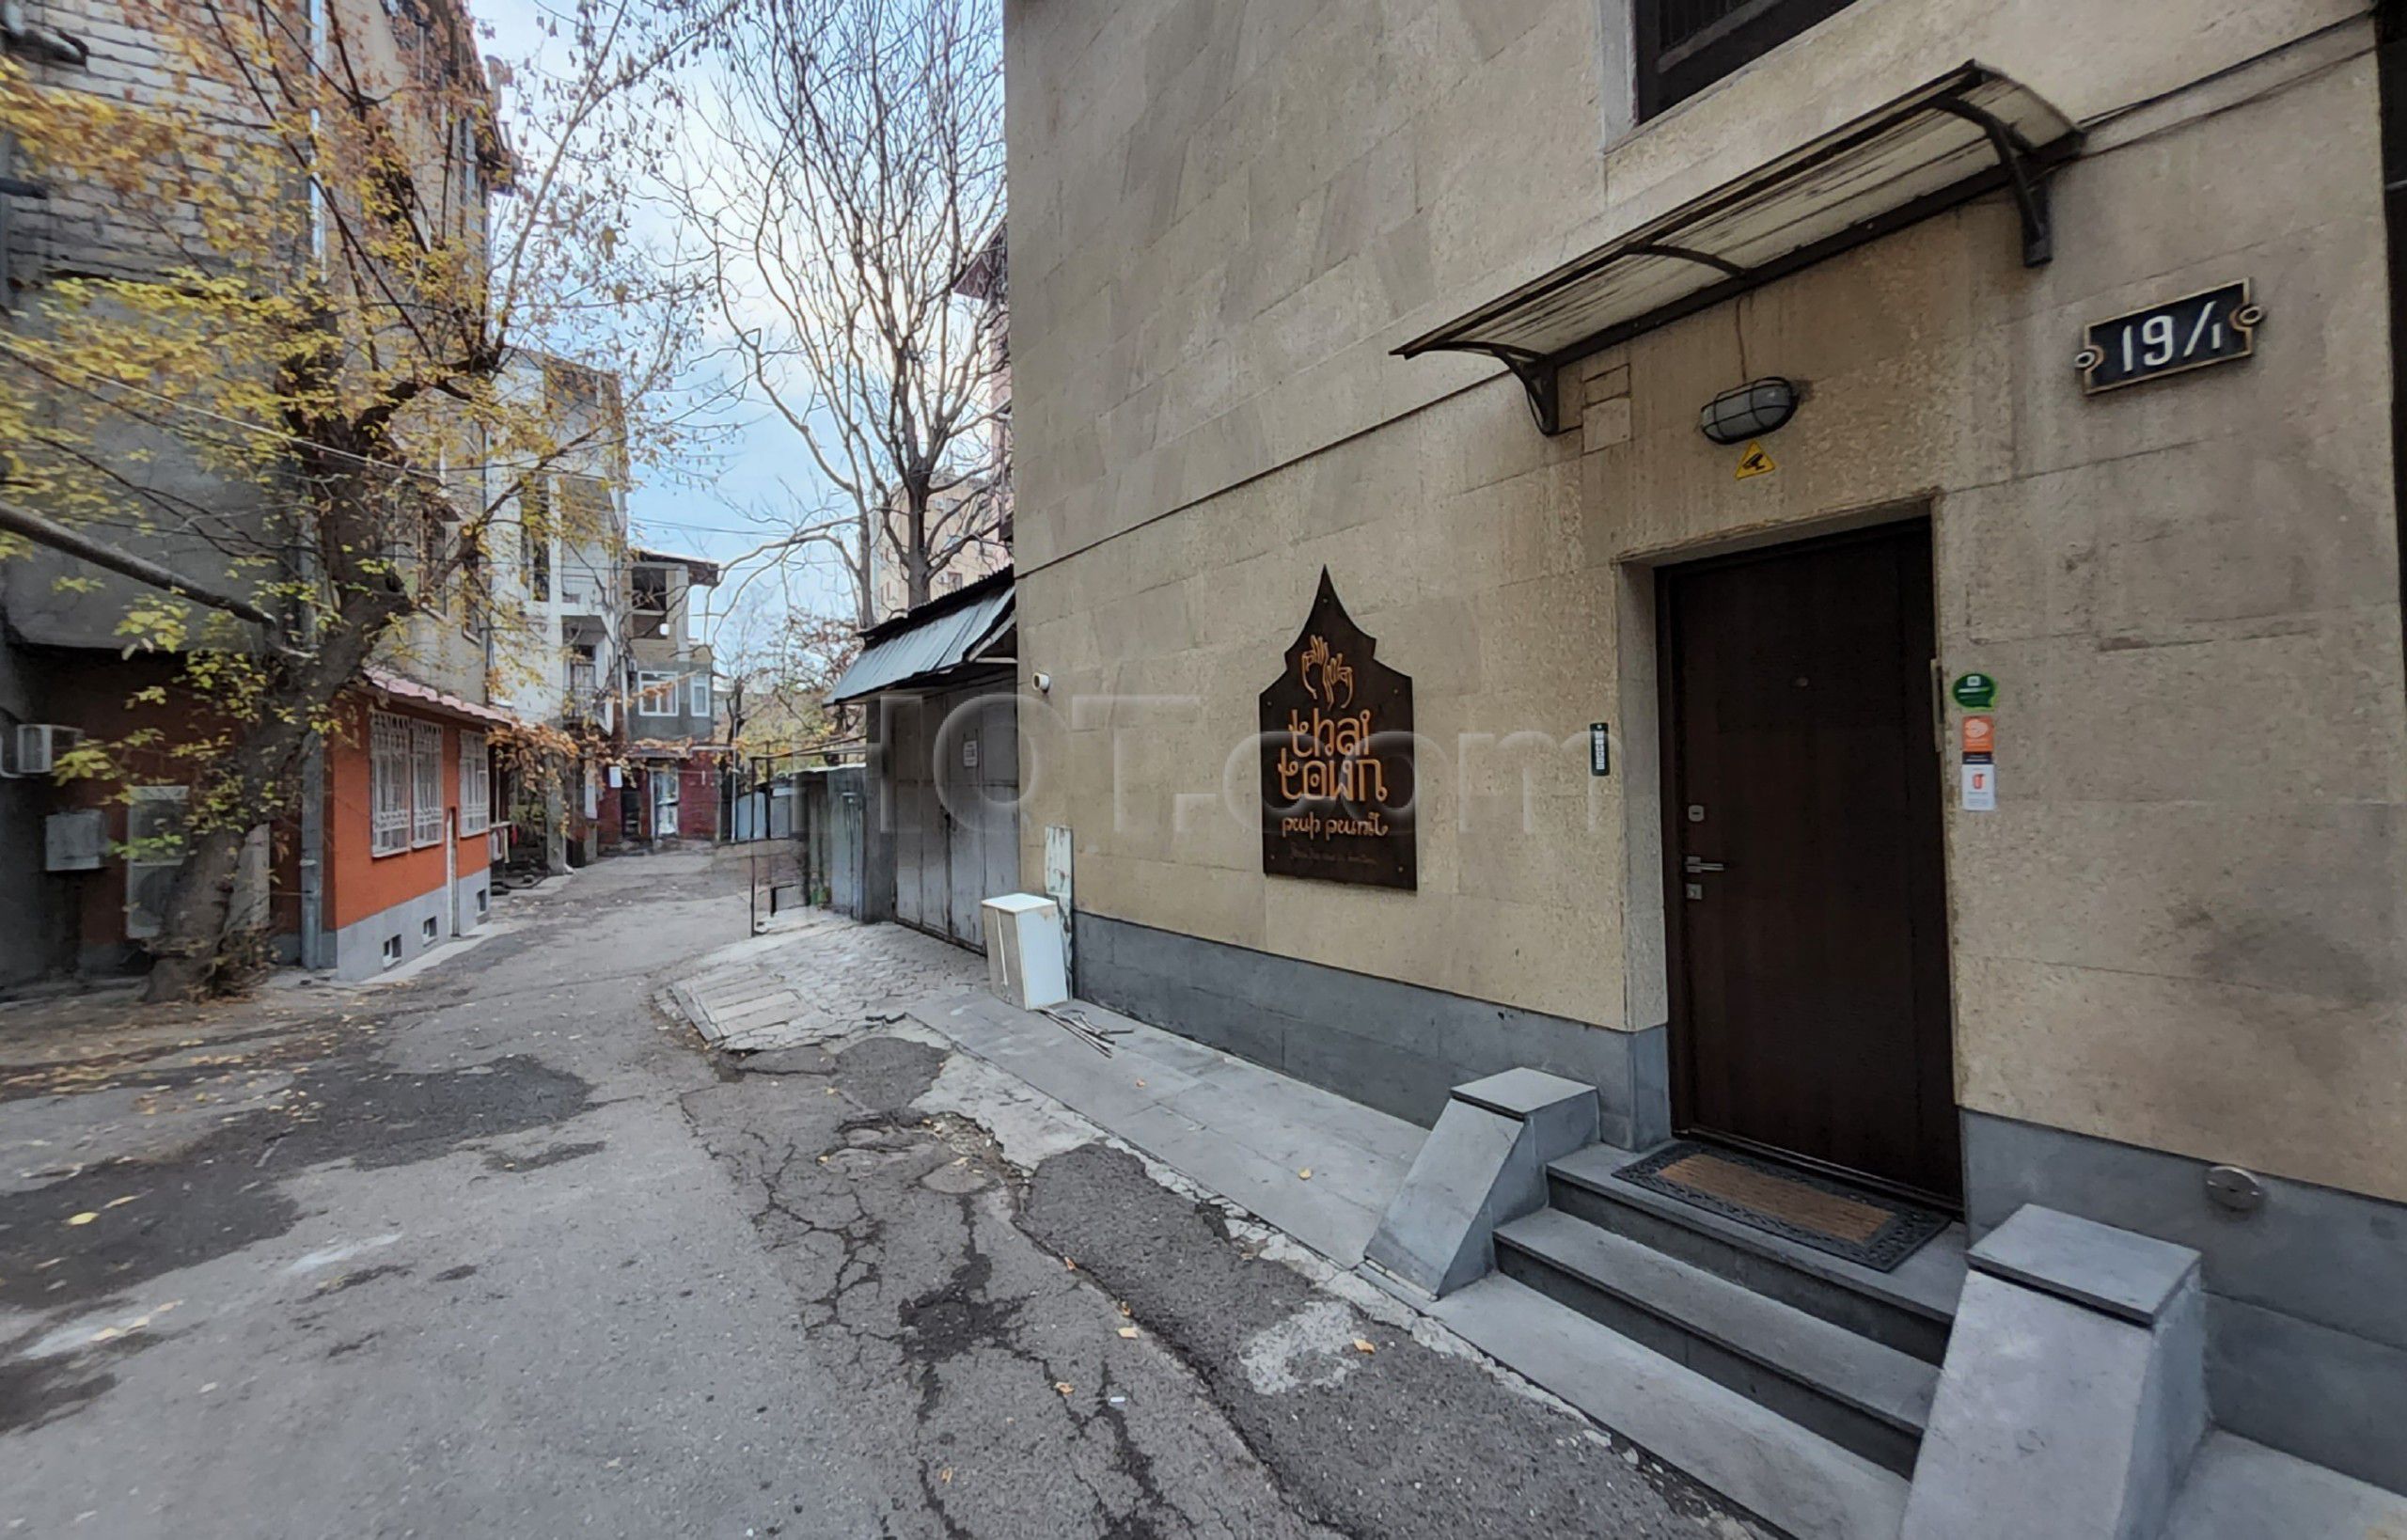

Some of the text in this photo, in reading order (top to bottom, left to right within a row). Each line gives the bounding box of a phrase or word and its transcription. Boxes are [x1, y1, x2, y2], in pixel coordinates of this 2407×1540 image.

[2121, 300, 2224, 372] 19/1
[1288, 707, 1371, 758] thai
[1277, 747, 1389, 802] town
